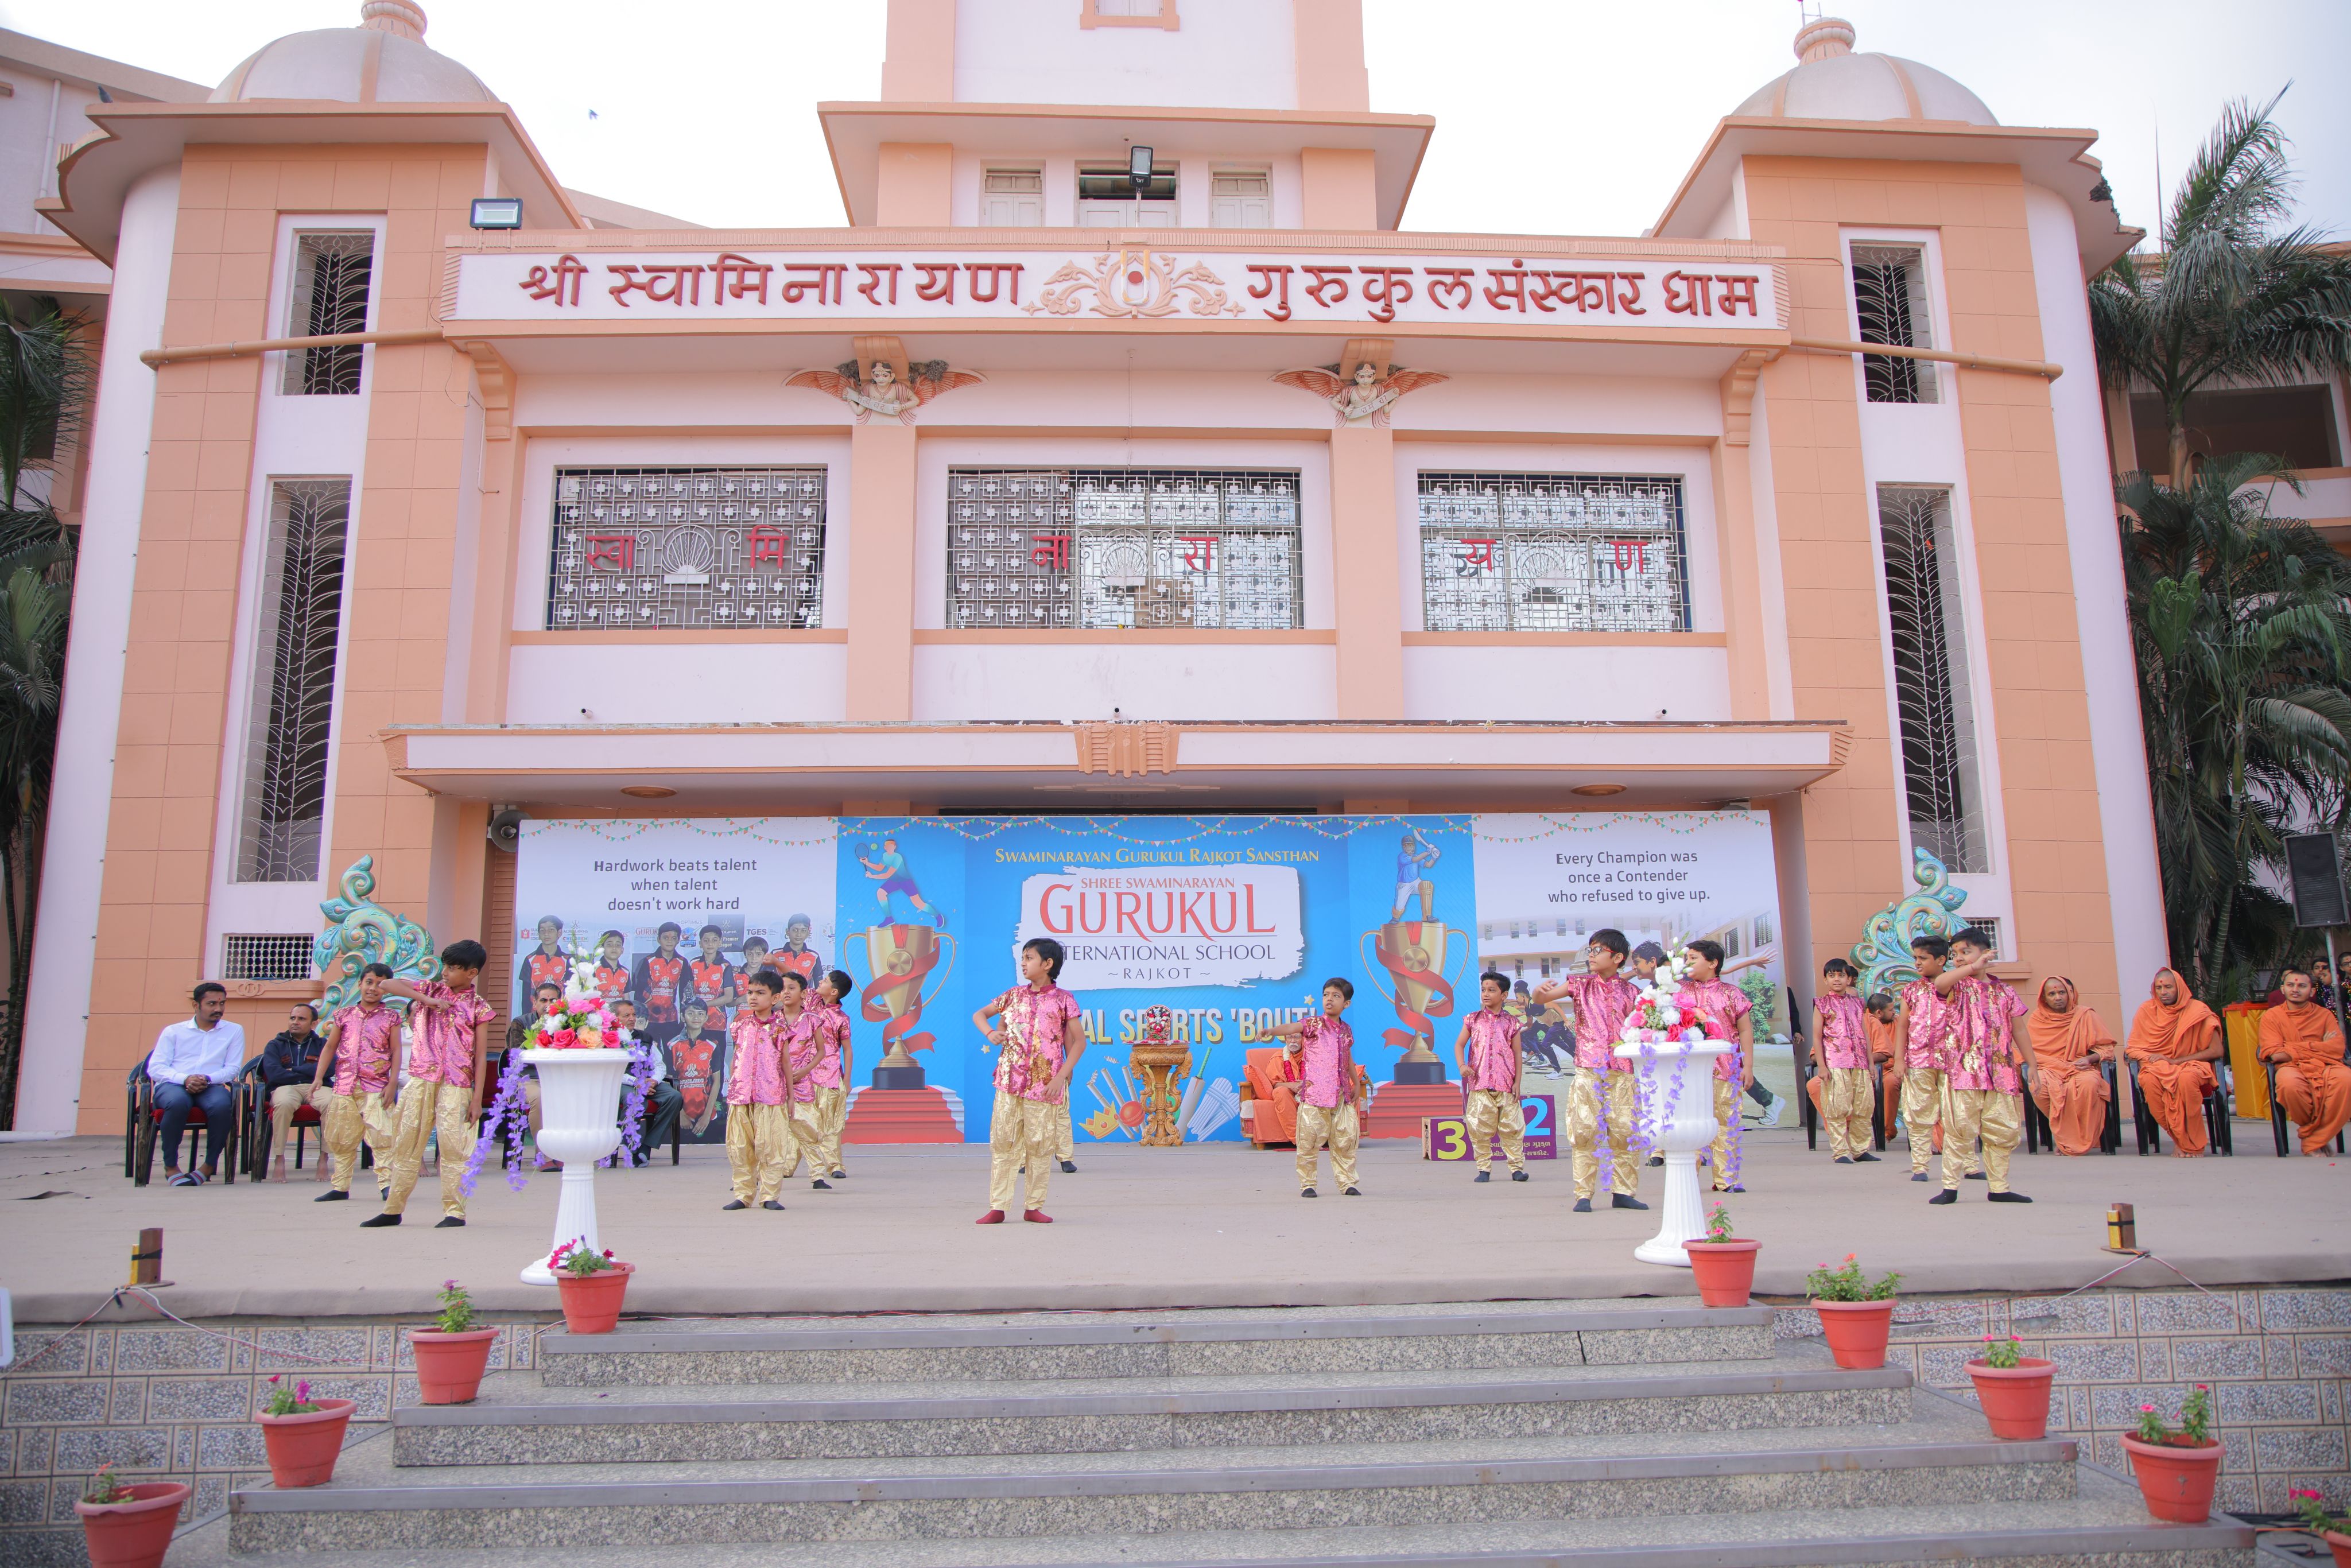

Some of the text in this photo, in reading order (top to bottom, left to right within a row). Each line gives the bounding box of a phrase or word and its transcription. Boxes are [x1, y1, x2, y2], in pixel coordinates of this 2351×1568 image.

[519, 254, 589, 308] श्री
[607, 253, 1025, 308] स्वामिनारायण
[1483, 258, 1645, 316] संस्कार
[1662, 269, 1759, 317] धाम
[995, 848, 1319, 864] SWAMINARAYAN GURUKUL RAJKOT SANSTHAN
[1556, 851, 1698, 867] Every Champion was
[594, 858, 758, 872] Hardwork beats talent
[1081, 878, 1235, 889] SHREE SWAMINARAYAN
[1568, 869, 1689, 883] once a Contender
[631, 878, 718, 891] when talent
[608, 896, 740, 910] doesn't work hard
[1548, 888, 1710, 904] who refused to give up.
[1039, 883, 1277, 942] GURUKUL
[1062, 945, 1275, 960] TERNATIONAL SCHOOL
[1119, 1008, 1224, 1043] SPRTS
[1520, 1097, 1550, 1136] 2
[1437, 1121, 1467, 1160] 3
